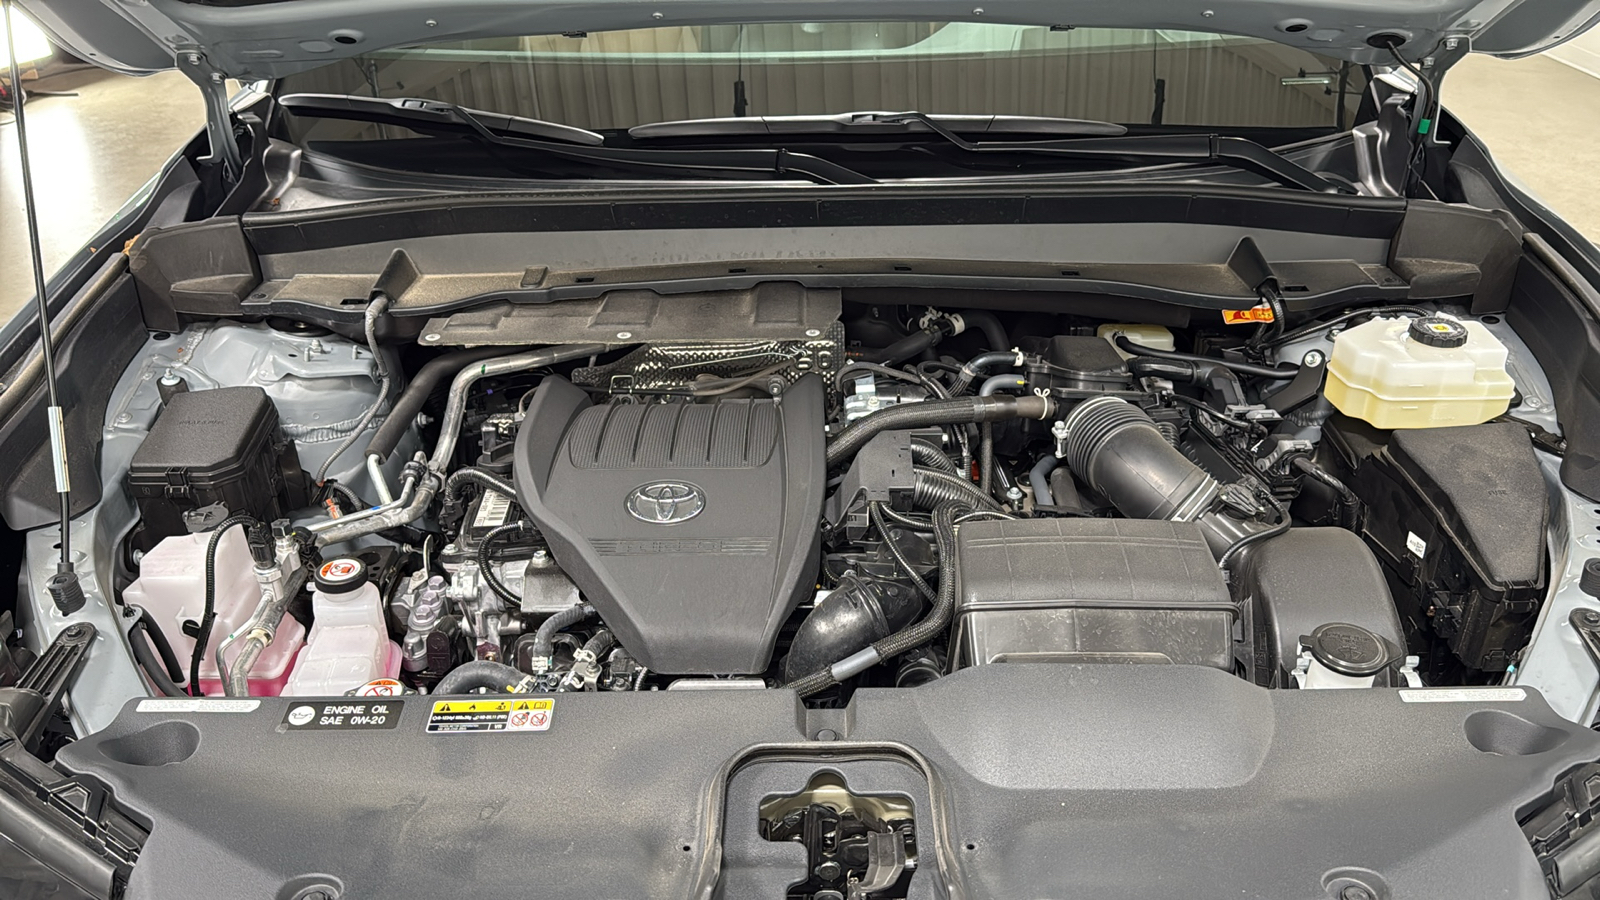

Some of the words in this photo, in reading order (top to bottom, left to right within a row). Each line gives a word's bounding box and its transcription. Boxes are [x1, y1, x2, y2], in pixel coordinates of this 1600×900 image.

[323, 705, 366, 715] ENGINE
[371, 704, 390, 714] OIL
[319, 716, 344, 726] SAE
[350, 715, 386, 725] 0W-20
